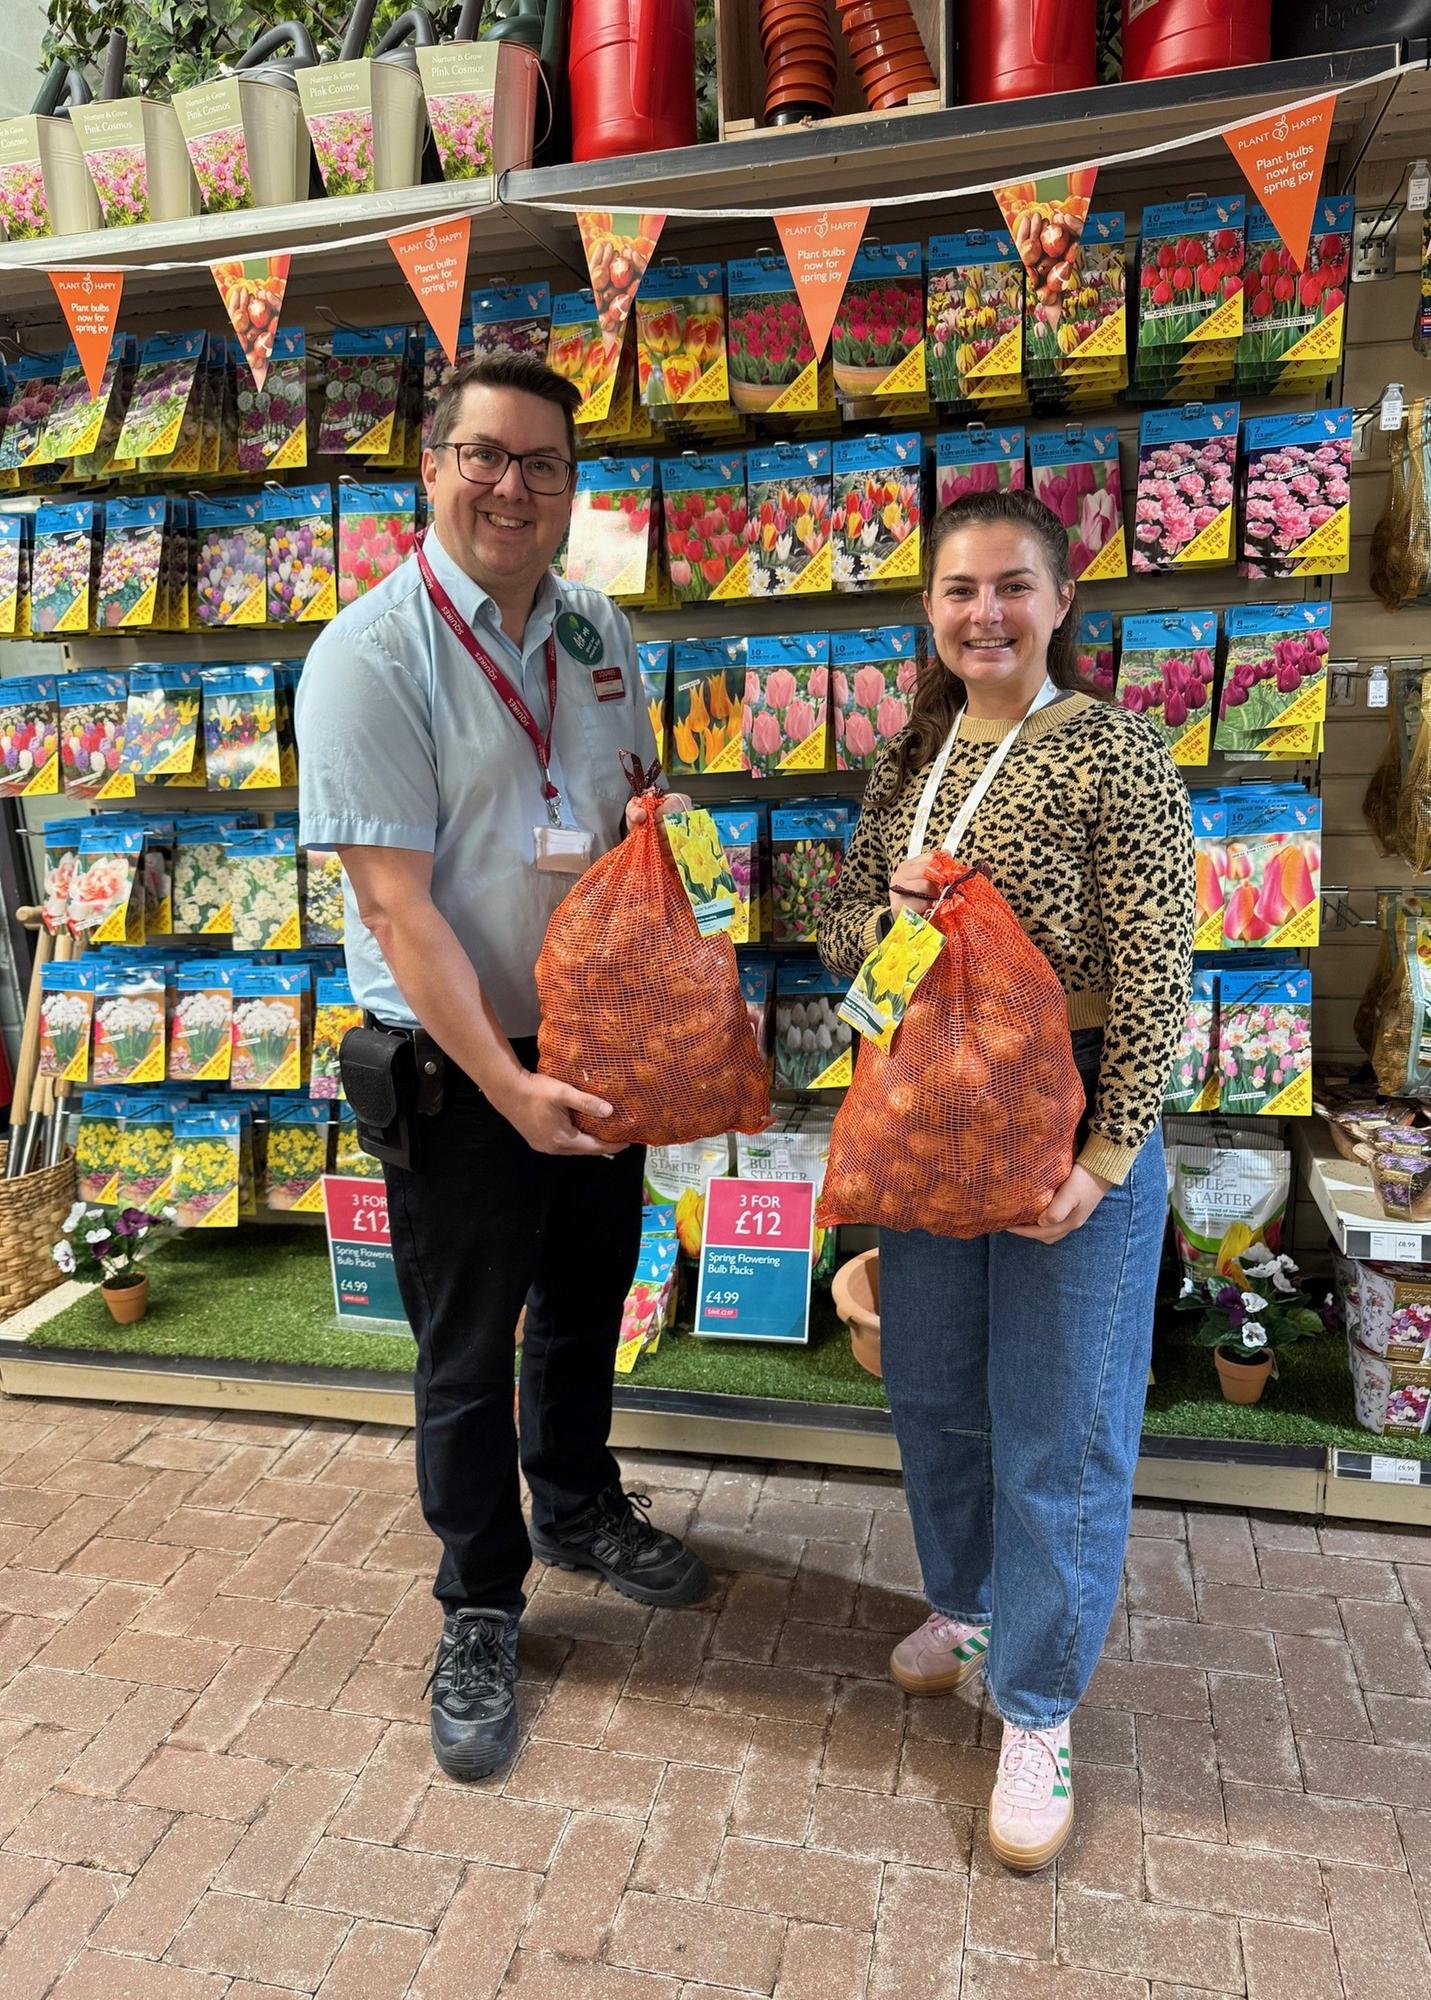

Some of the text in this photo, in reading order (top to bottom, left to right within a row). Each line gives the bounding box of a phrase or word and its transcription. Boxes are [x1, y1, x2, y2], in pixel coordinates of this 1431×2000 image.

[1313, 0, 1377, 32] flopro
[431, 64, 485, 78] Pink Cosmos
[310, 82, 360, 97] Pink Cosmos
[187, 102, 231, 120] Pink Cosmos
[84, 120, 133, 135] Pink Cosmos
[1238, 113, 1324, 150] PLANT HAPPY
[1256, 144, 1314, 171] Plant bulbs
[1265, 158, 1308, 180] now for
[1263, 170, 1314, 195] spring joy
[785, 221, 857, 236] PLANT HAPPY
[400, 231, 463, 254] PLANT HAPPY
[798, 248, 846, 260] Plant bulbs
[414, 258, 458, 274] Plant bulbs
[804, 259, 839, 270] now for
[422, 268, 454, 284] now for
[801, 270, 843, 284] spring joy
[58, 281, 116, 290] PLANT HAPPY
[420, 279, 458, 296] spring joy
[71, 302, 110, 313] Plant bulbs
[77, 312, 104, 322] now for
[1194, 322, 1213, 338] BEST
[1212, 300, 1239, 322] SELLER
[1220, 312, 1236, 329] FOR
[75, 323, 109, 336] spring joy
[1079, 315, 1122, 354] BEST SELLER
[1103, 329, 1118, 346] FOR
[1290, 340, 1310, 357] BEST
[1310, 315, 1338, 340] SELLER
[1316, 331, 1332, 349] FOR
[976, 334, 1018, 374] BEST SELLER
[1000, 350, 1014, 366] FOR
[883, 350, 921, 392] BEST SELLER
[905, 366, 920, 383] FOR
[1168, 466, 1194, 478] FRAGRANT
[1280, 468, 1308, 480] FRAGRANT
[1184, 516, 1227, 558] BEST SELLER
[1208, 532, 1224, 548] FOR
[1300, 515, 1344, 554] BEST SELLER
[1324, 528, 1340, 545] FOR
[878, 538, 916, 576] BEST SELLER
[898, 552, 913, 567] FOR
[442, 606, 464, 635] SQUIRES
[475, 652, 498, 682] SQUIRES
[508, 698, 530, 727] SQUIRES
[1278, 686, 1322, 724] BEST SELLER
[1302, 699, 1318, 714] FOR
[1274, 907, 1316, 945] BEST SELLER
[1298, 922, 1312, 936] FOR
[352, 1194, 388, 1207] 3 FOR
[739, 1195, 780, 1208] 3 FOR
[1184, 1190, 1252, 1206] STARTER
[352, 1209, 390, 1233] £12
[735, 1210, 782, 1236] £12
[336, 1246, 360, 1258] Spring
[708, 1252, 780, 1267] Spring Flowering
[337, 1256, 376, 1268] Bulb Packs
[708, 1264, 754, 1276] Bulb Packs
[340, 1280, 368, 1292] £4.99
[705, 1290, 740, 1304] £4.99
